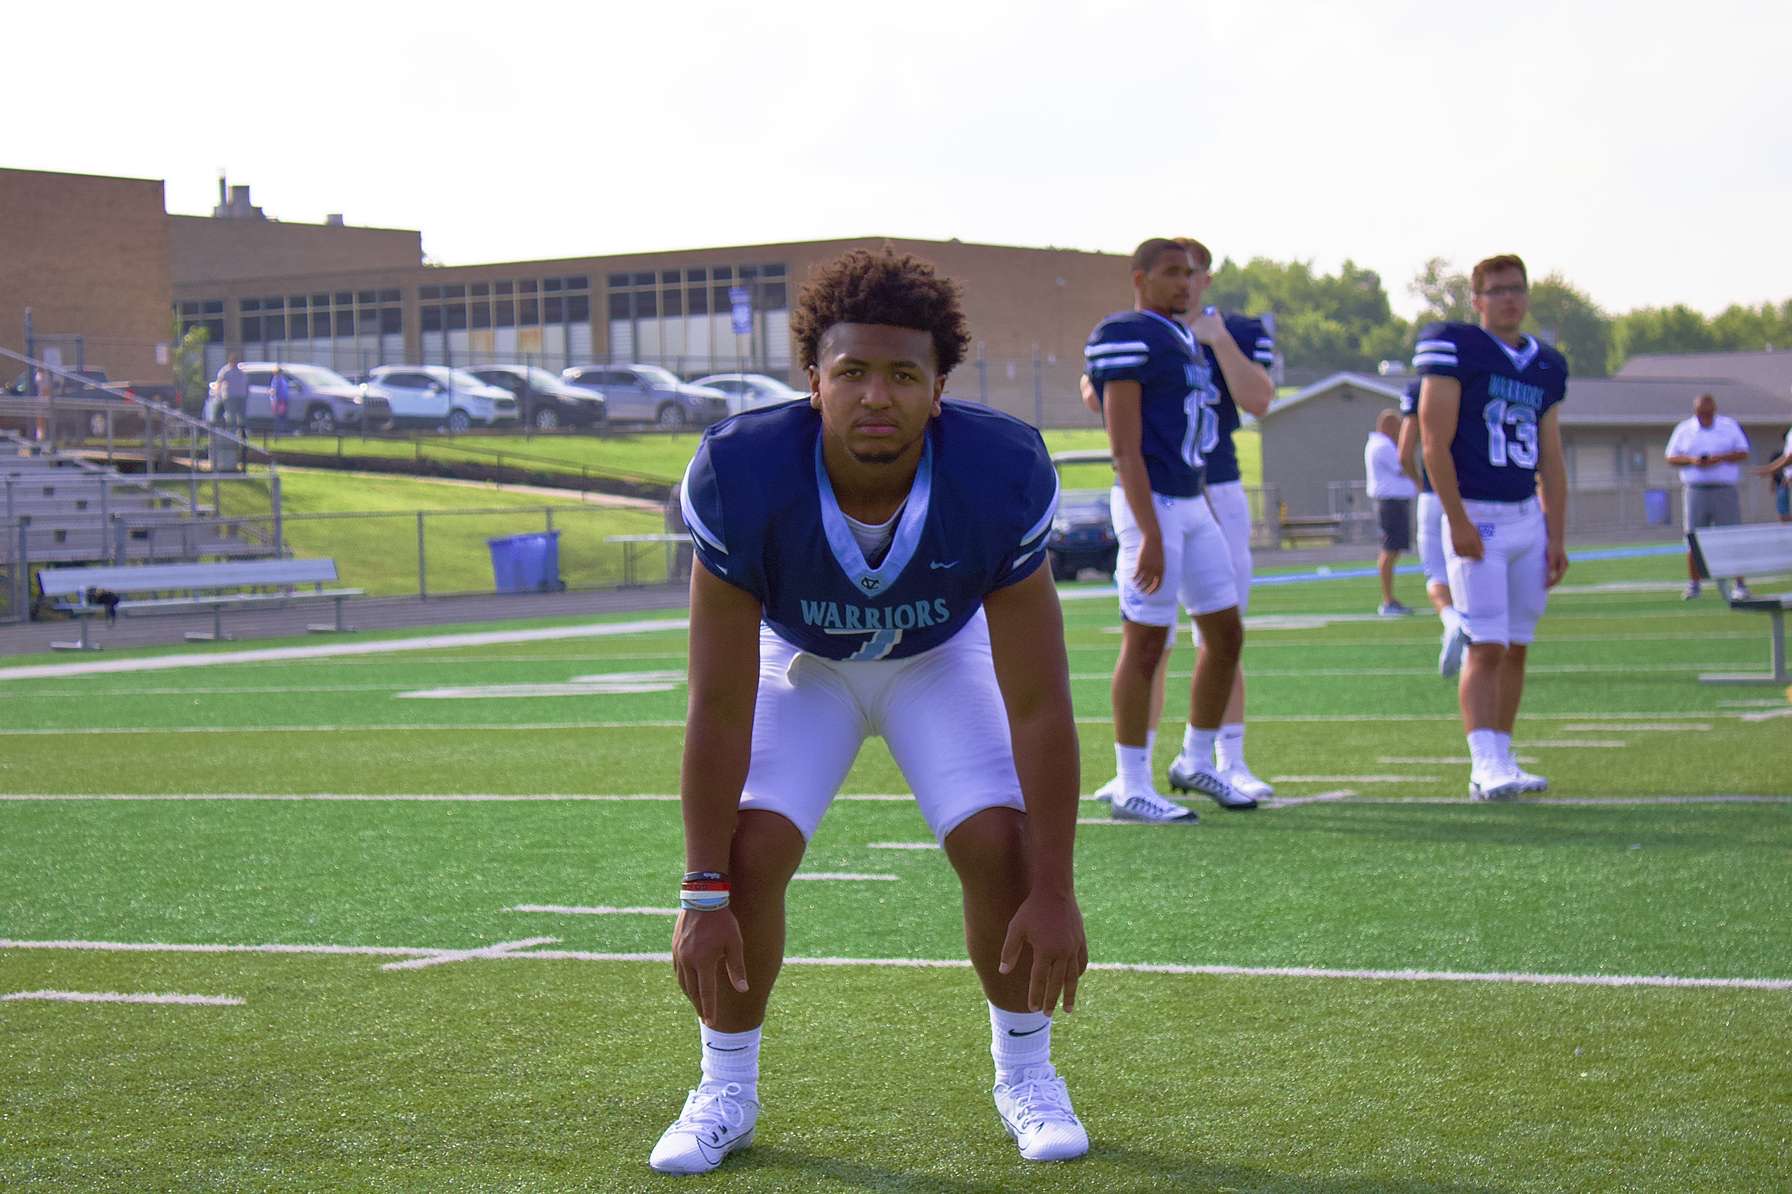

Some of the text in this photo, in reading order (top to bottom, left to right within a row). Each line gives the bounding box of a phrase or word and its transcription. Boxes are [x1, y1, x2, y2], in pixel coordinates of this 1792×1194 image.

[1482, 399, 1538, 469] 13
[800, 598, 950, 630] WARRIORS
[824, 628, 903, 661] 7
